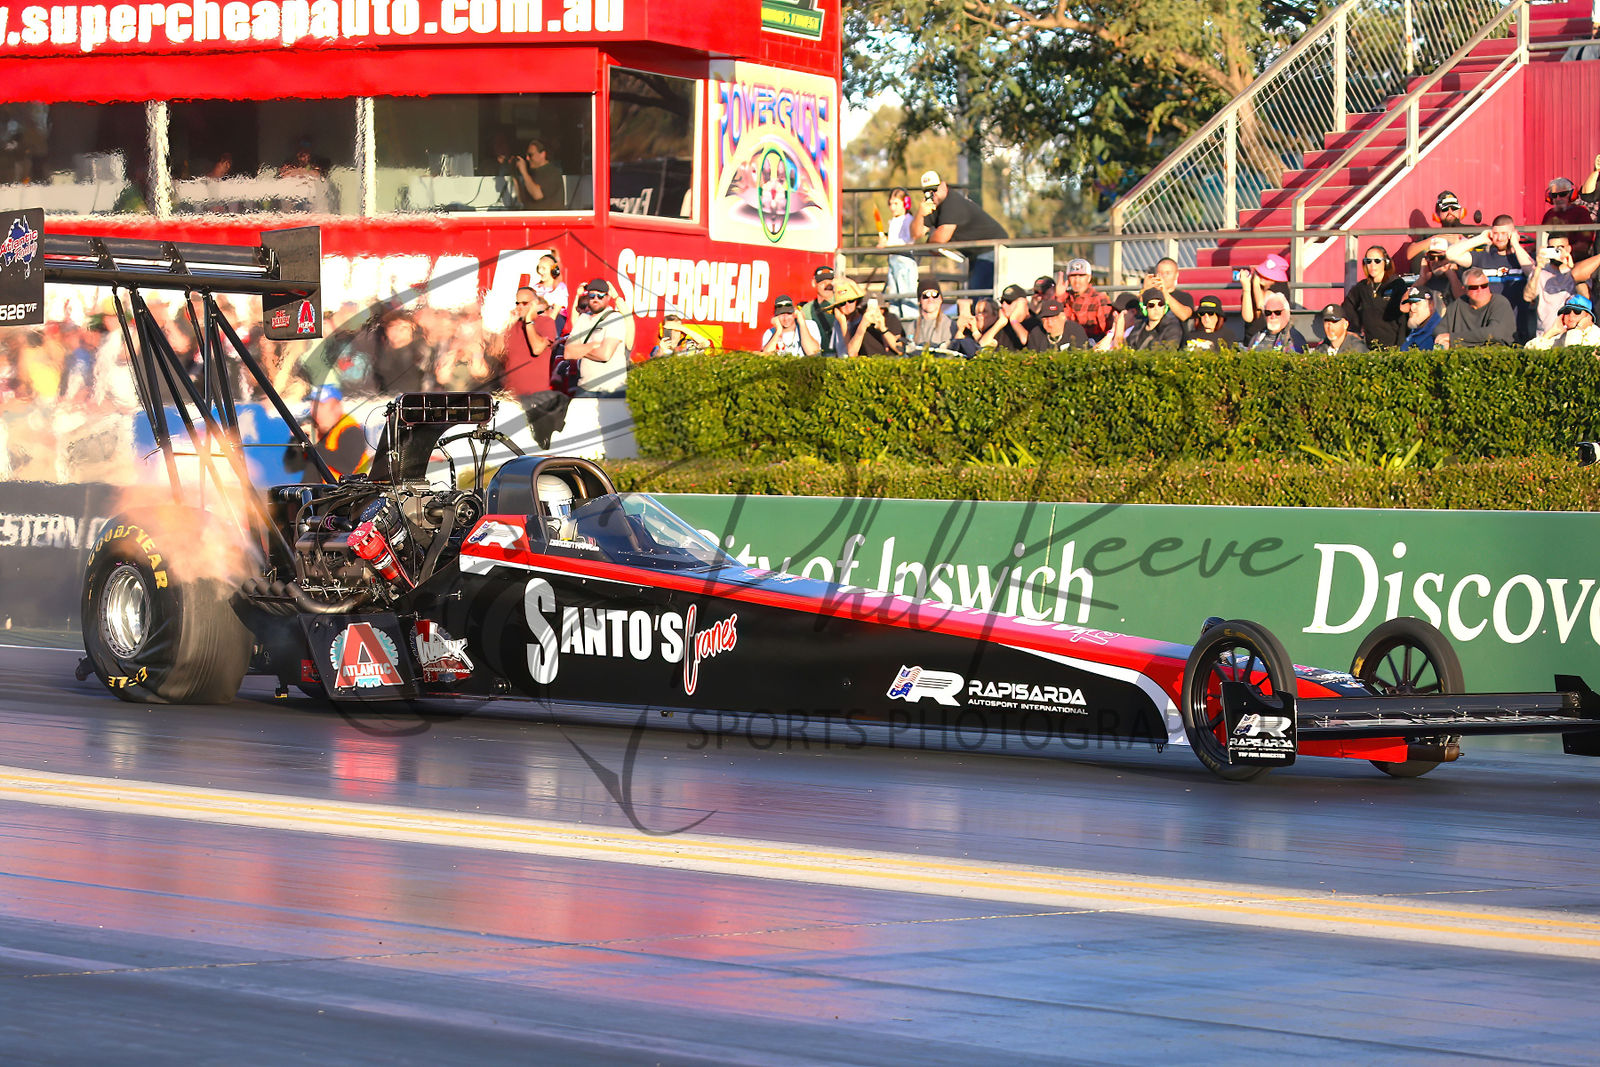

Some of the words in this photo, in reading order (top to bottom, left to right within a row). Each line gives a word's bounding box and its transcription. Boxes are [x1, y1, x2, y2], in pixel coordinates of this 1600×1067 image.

[0, 230, 38, 257] Atlantic
[617, 248, 770, 329] SUPERCHEAP
[874, 536, 1094, 624] Ipswich
[1302, 541, 1600, 645] Discov
[343, 664, 392, 677] ATLANTIC
[683, 603, 738, 696] Cranes
[968, 679, 1087, 706] RAPISARDA
[968, 698, 1019, 709] AUTOSPORT
[1020, 702, 1089, 715] INTERNATIONAL
